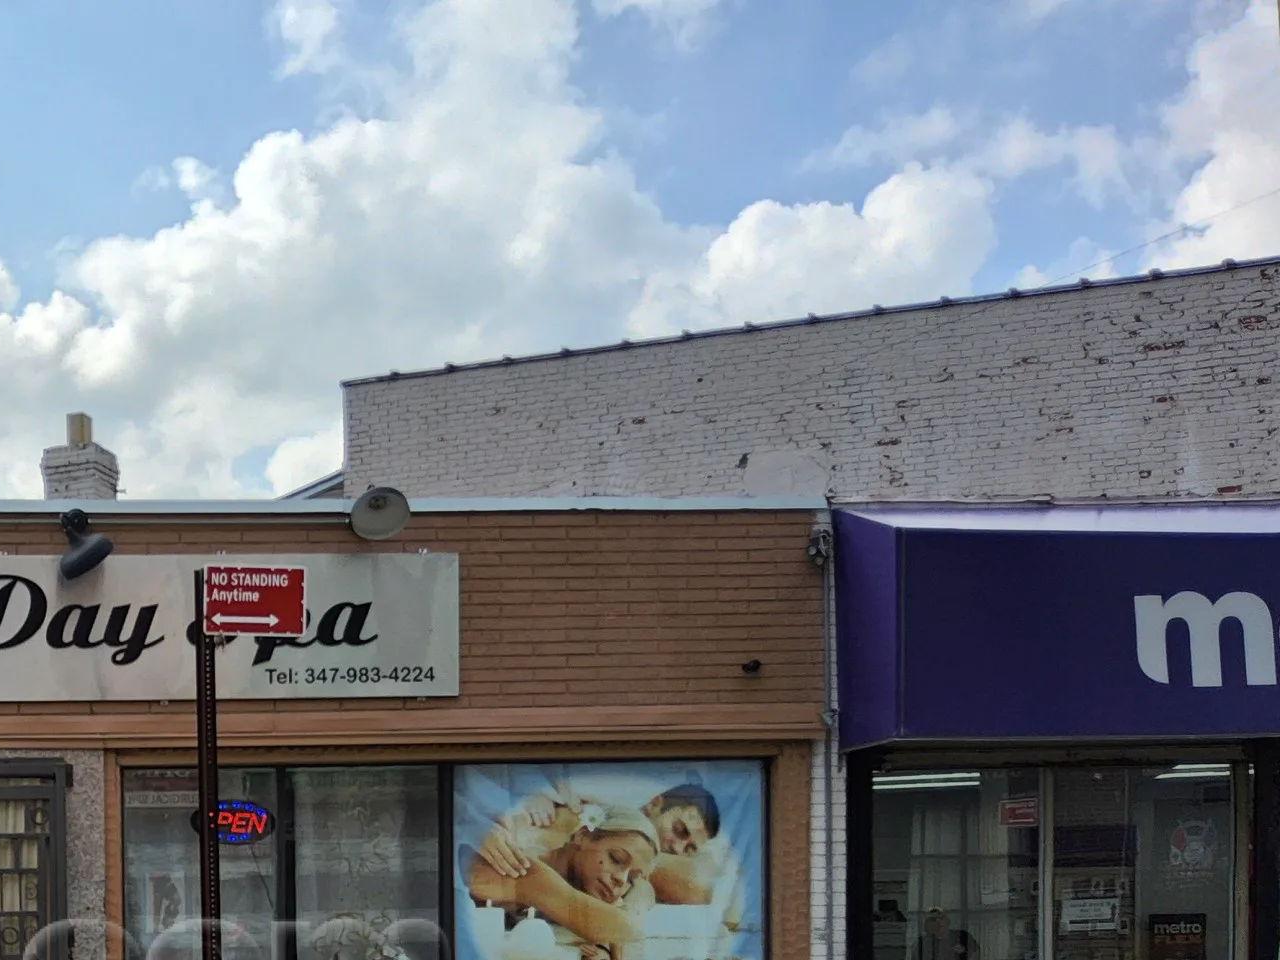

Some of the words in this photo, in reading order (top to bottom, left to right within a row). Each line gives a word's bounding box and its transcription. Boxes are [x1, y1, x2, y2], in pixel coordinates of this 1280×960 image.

[211, 572, 227, 586] NO
[231, 573, 288, 587] STANDING
[211, 589, 260, 602] Anytime
[265, 668, 299, 684] Tel:
[305, 666, 435, 684] 347-983-4224
[208, 811, 267, 834] PEN
[1154, 921, 1202, 934] metro
